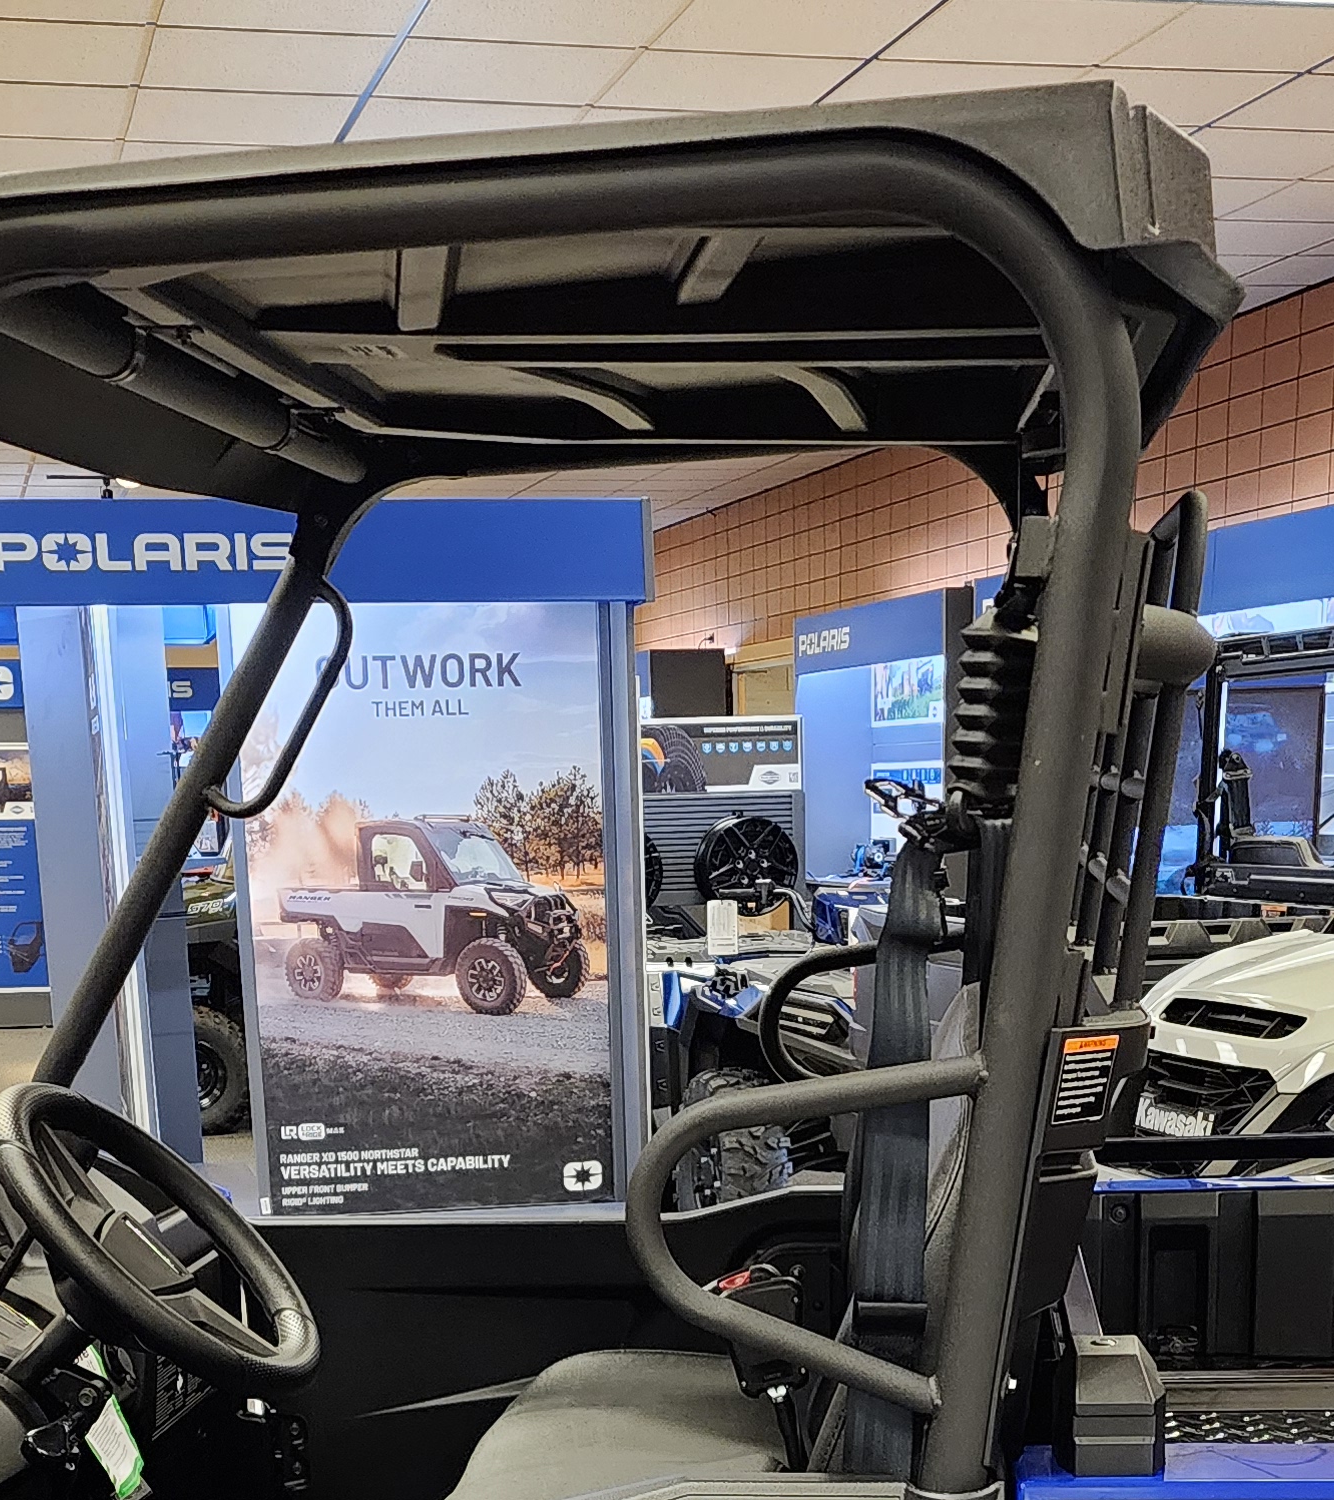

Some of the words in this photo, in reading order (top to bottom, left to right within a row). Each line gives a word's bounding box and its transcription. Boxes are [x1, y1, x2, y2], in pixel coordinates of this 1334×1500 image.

[798, 626, 850, 657] POLARIS
[372, 700, 424, 717] THEM
[431, 699, 469, 716] ALL
[1135, 1097, 1215, 1137] Kawasaki
[280, 1153, 320, 1164] RANGER
[321, 1152, 336, 1162] XD
[337, 1151, 359, 1161] 1500
[361, 1148, 419, 1160] NORTHSTAR
[280, 1162, 373, 1180] VERSATILITY
[376, 1159, 425, 1175] MEETS
[427, 1155, 511, 1172] CAPABILITY
[282, 1186, 307, 1195] UPPER
[309, 1185, 335, 1194] FRONT
